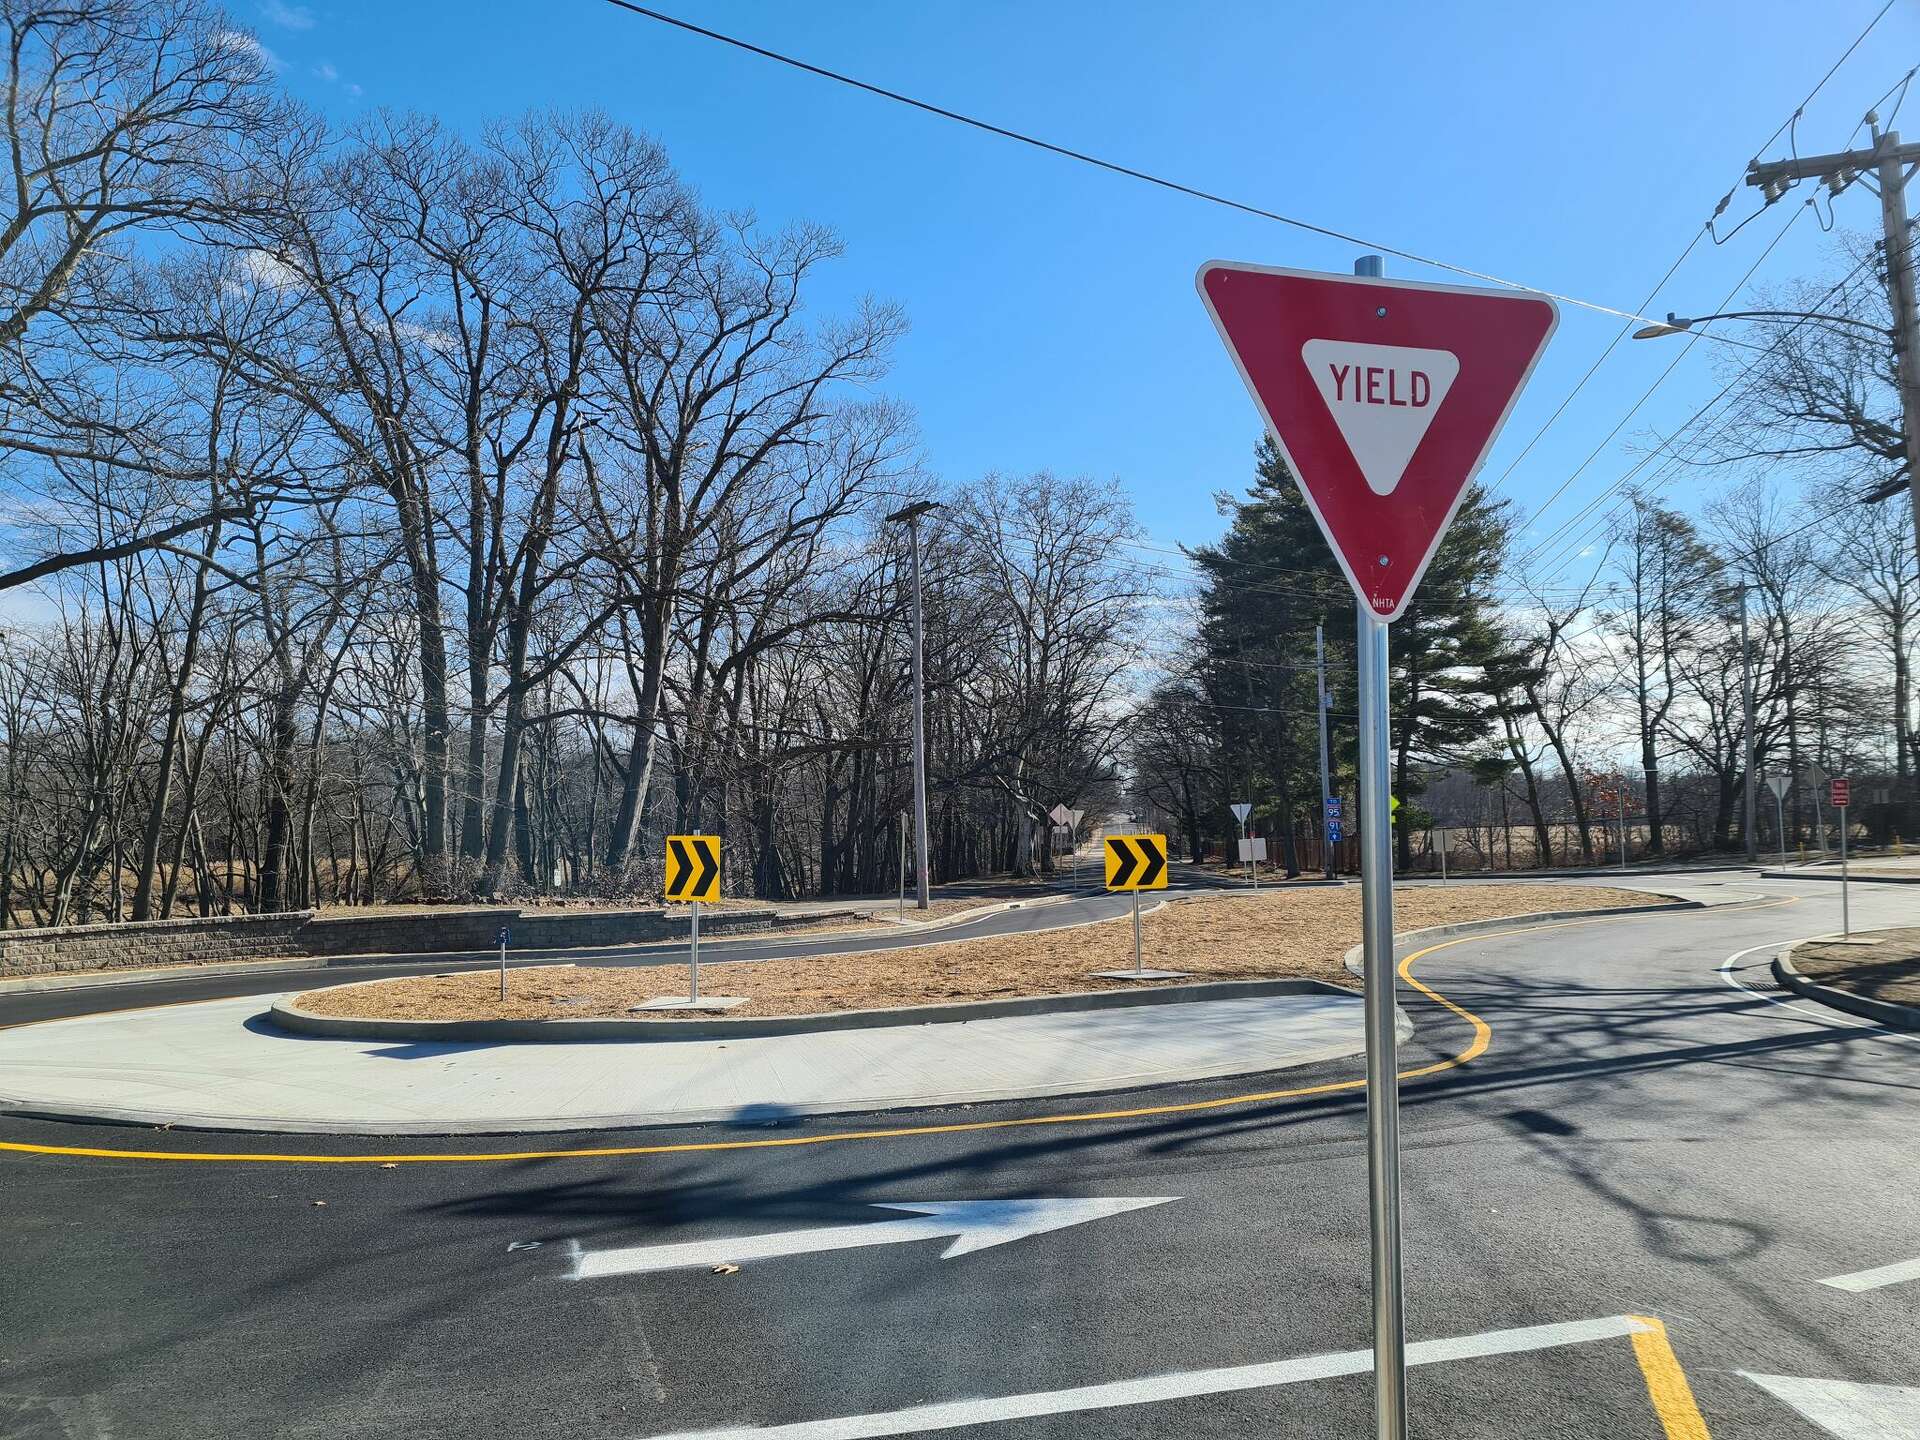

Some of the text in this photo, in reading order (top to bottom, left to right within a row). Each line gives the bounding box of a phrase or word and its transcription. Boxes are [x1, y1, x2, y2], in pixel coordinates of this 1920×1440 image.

[1329, 363, 1431, 408] YIELD
[1372, 597, 1396, 609] NHTA
[1328, 808, 1340, 817] 95
[1329, 821, 1339, 831] 91
